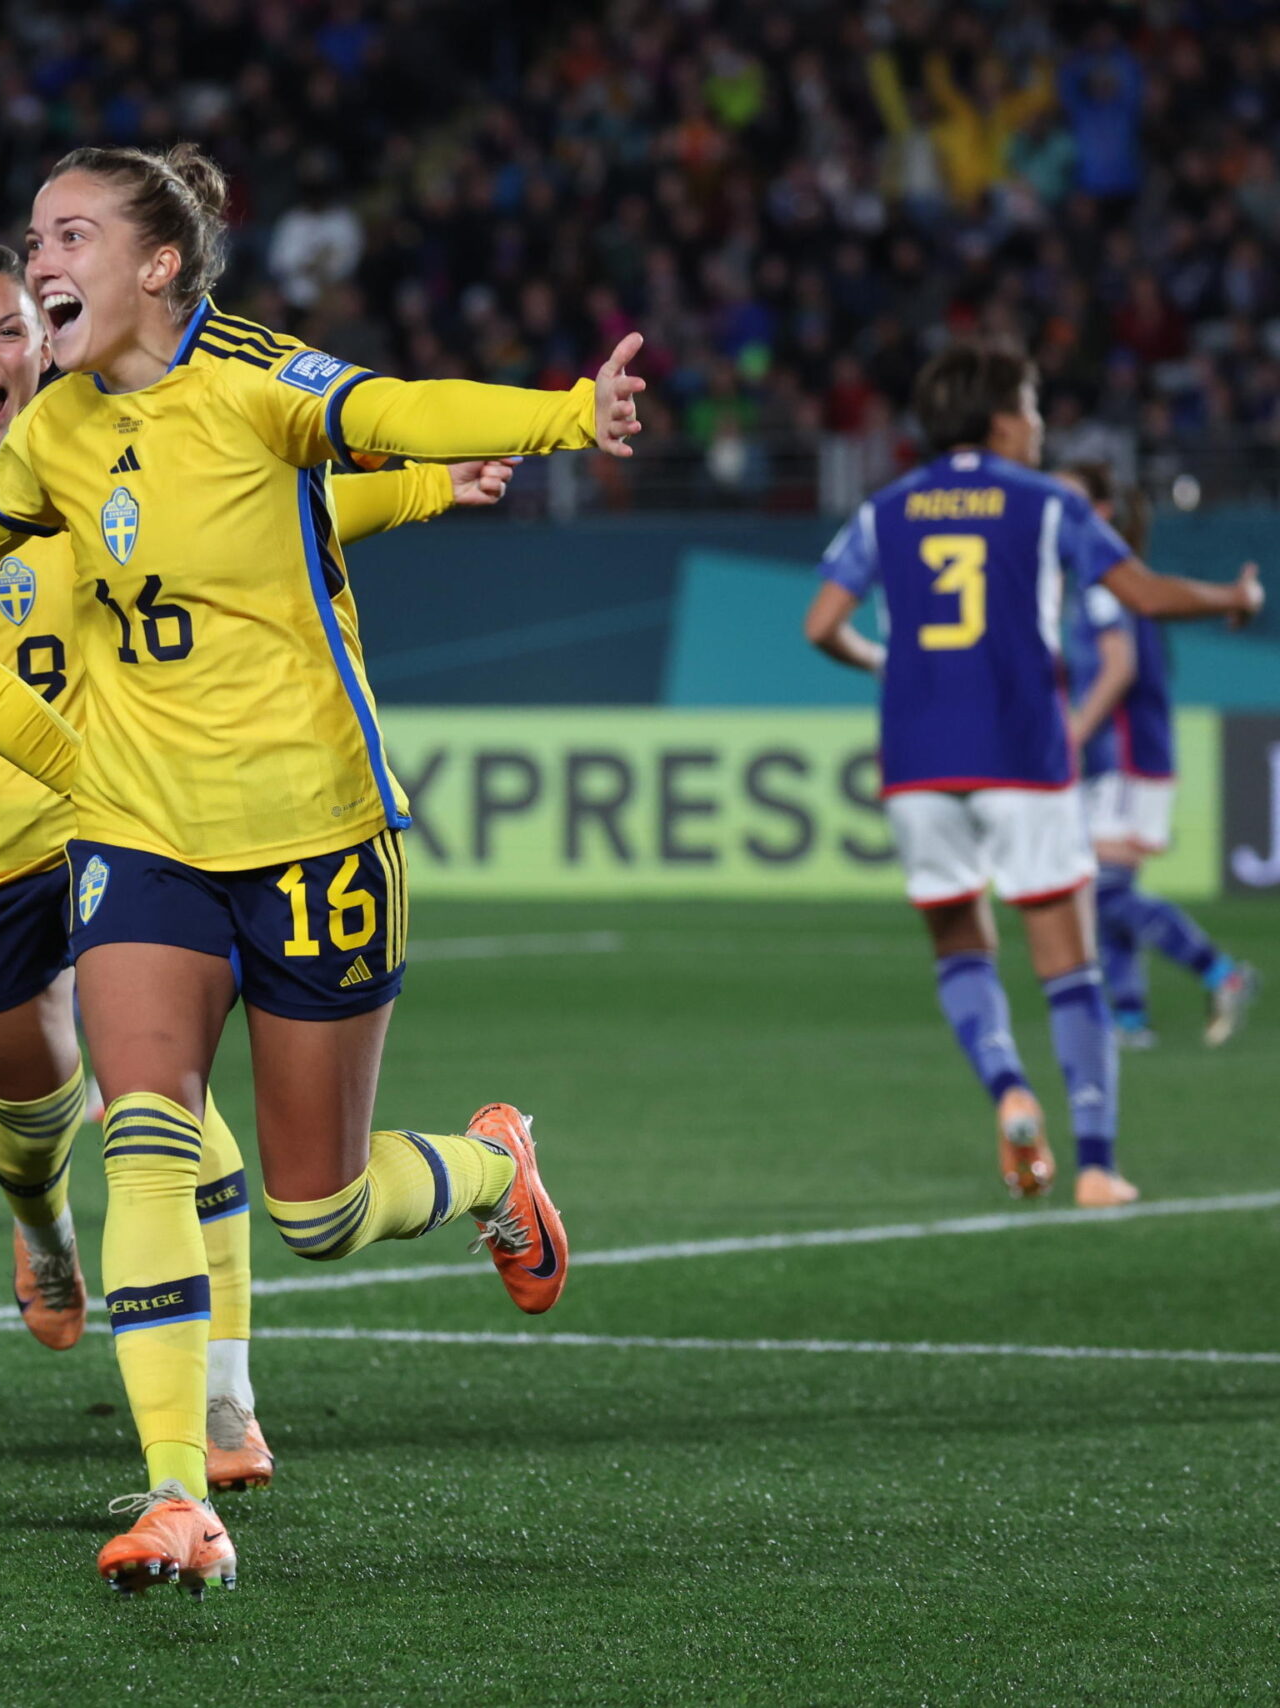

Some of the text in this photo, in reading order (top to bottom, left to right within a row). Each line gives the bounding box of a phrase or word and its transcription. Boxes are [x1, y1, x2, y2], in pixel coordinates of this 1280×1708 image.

[96, 574, 194, 664] 16
[919, 533, 987, 649] 3
[277, 855, 376, 956] 16
[108, 1291, 184, 1315] ERIGE
